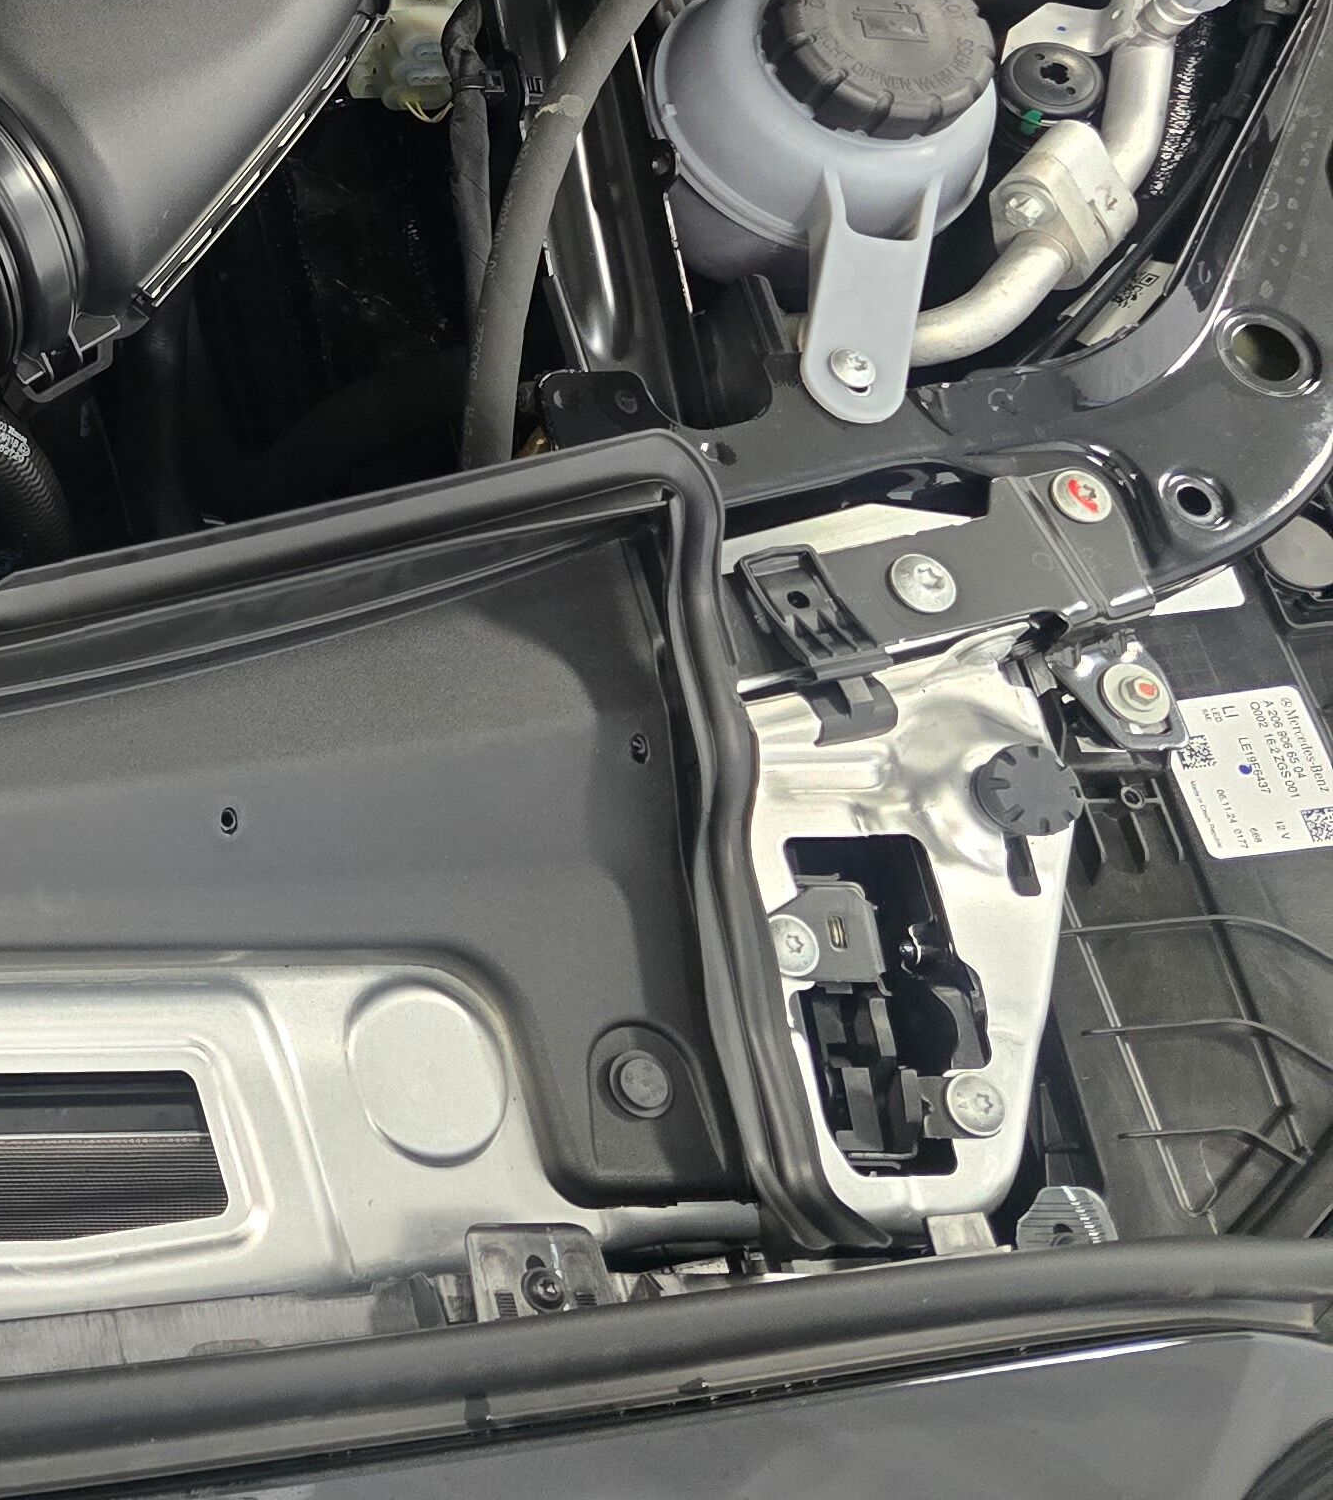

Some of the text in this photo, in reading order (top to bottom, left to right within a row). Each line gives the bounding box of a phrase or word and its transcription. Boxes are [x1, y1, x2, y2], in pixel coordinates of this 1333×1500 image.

[1210, 708, 1223, 723] LED
[1221, 705, 1239, 719] LI
[1249, 701, 1269, 729] Q002
[1273, 755, 1292, 780] ZGS
[1284, 779, 1300, 799] 001
[1263, 700, 1307, 779] A 206 906 65 04
[1284, 707, 1331, 794] Mercedes-Benz
[1275, 821, 1291, 840] 12 V
